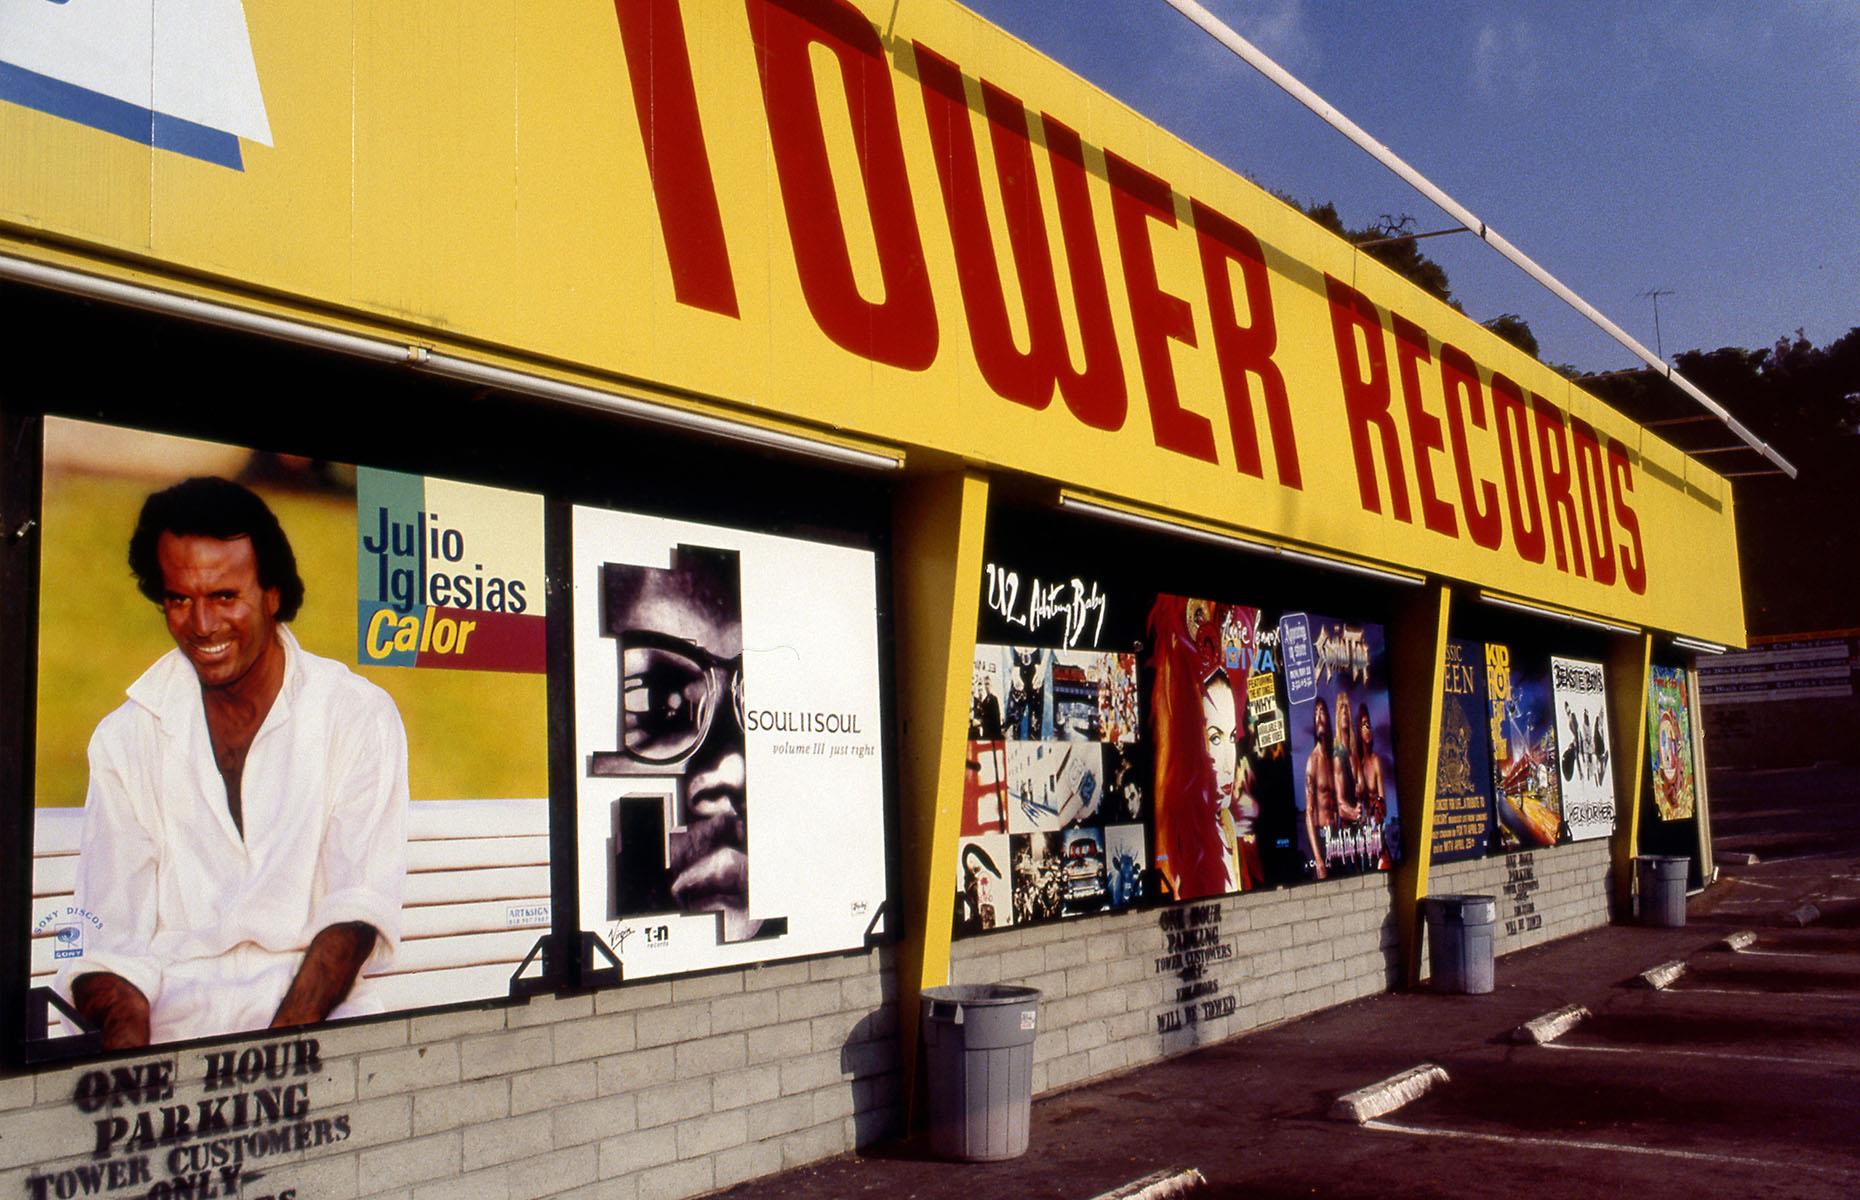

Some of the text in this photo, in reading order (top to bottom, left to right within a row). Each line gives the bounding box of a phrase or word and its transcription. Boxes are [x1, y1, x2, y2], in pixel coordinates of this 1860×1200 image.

[614, 0, 1647, 596] TOWER RECORDS
[363, 506, 464, 562] Julio
[379, 553, 527, 614] Iglesias
[985, 563, 1026, 626] U2
[1069, 578, 1105, 648] Baby
[366, 607, 476, 659] Calor
[1226, 646, 1276, 672] DIVA
[1445, 644, 1462, 661] SSIC
[1485, 643, 1509, 666] KID
[1443, 663, 1473, 694] EEN
[773, 741, 875, 759] volume III just right
[34, 907, 104, 935] SONY DISCOS
[1159, 903, 1222, 931] ONE HOUR
[55, 949, 82, 959] SONY
[608, 918, 636, 954] Virgin
[1167, 925, 1219, 953] PARKING
[1155, 944, 1232, 974] TOWER CUSTOMERS
[1157, 995, 1236, 1034] WILL BE TOWED
[75, 1038, 323, 1113] ONE HOUR
[93, 1082, 311, 1159] PARKING
[26, 1115, 352, 1200] TOWER CUSTOMERS
[149, 1163, 243, 1200] ONLY
